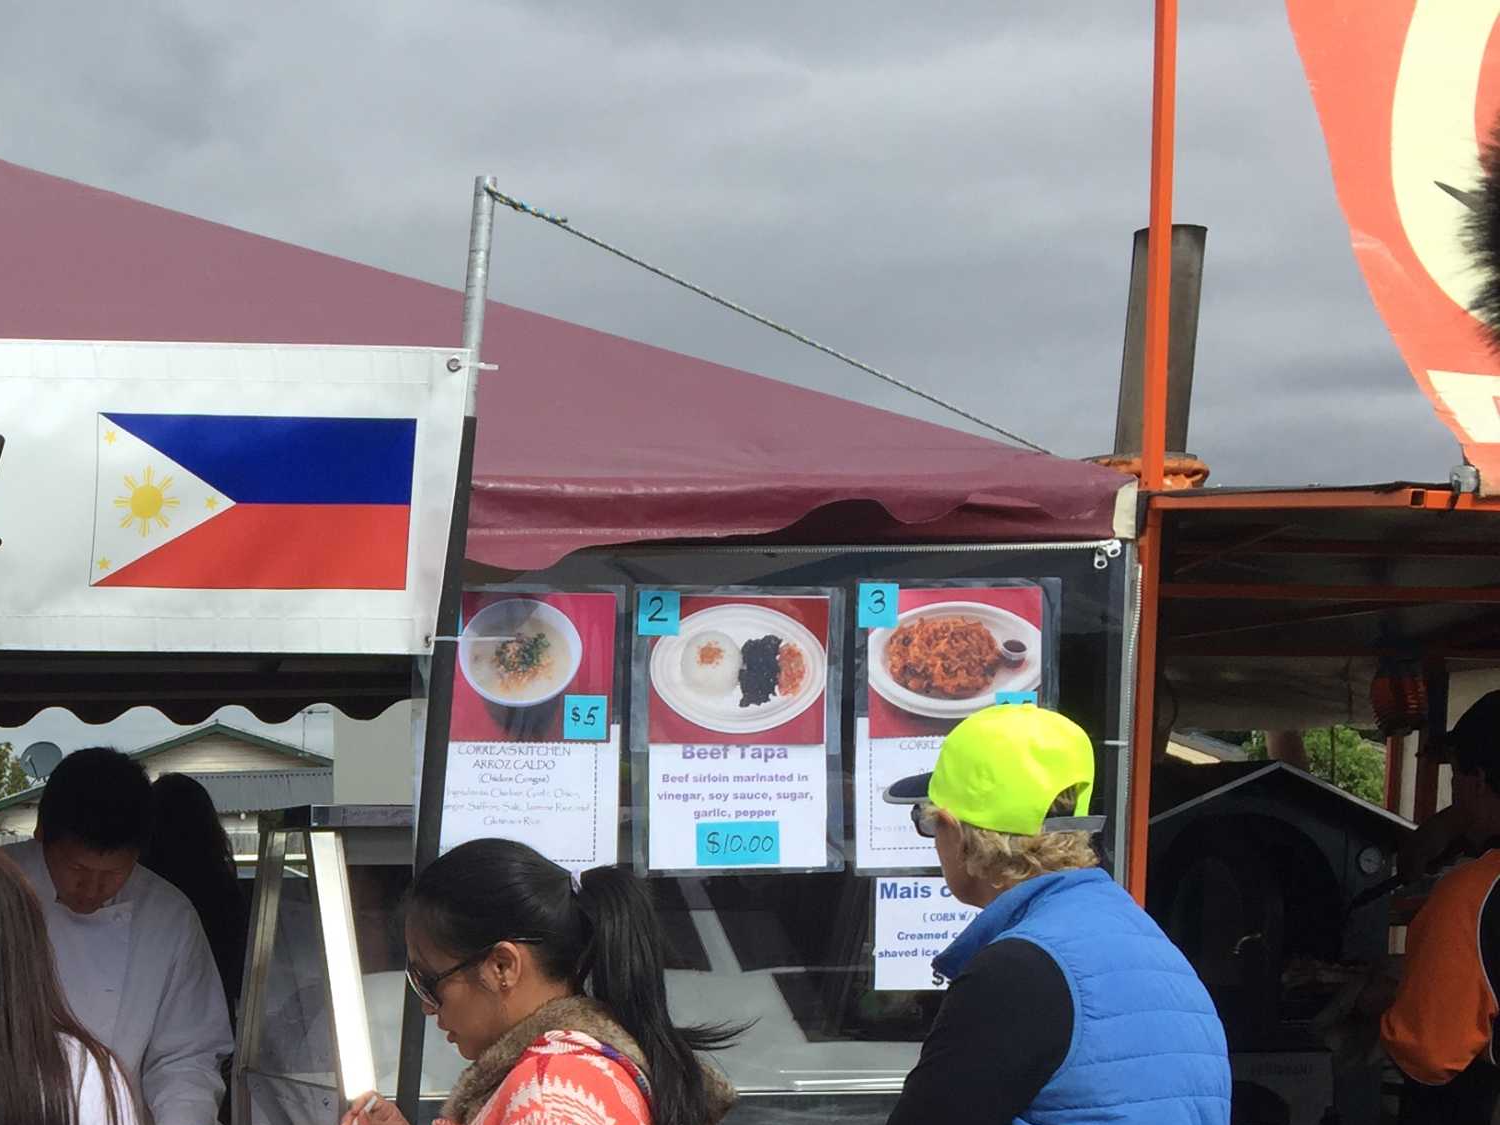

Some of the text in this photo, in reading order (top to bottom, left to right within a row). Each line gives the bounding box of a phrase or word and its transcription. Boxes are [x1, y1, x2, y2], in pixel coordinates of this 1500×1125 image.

[868, 589, 886, 614] 3
[648, 596, 668, 622] 2
[571, 705, 600, 727] $5
[682, 745, 788, 763] Beef Tapa
[513, 759, 556, 770] CALDO
[662, 772, 809, 783] Beef sirloin marinated in
[657, 791, 813, 802] vinegar, soy sauce, sugar,
[693, 809, 776, 820] garlic, pepper
[706, 831, 774, 855] $10.00
[880, 882, 932, 899] Mais
[897, 931, 948, 941] Creamed
[878, 948, 918, 958] shaved
